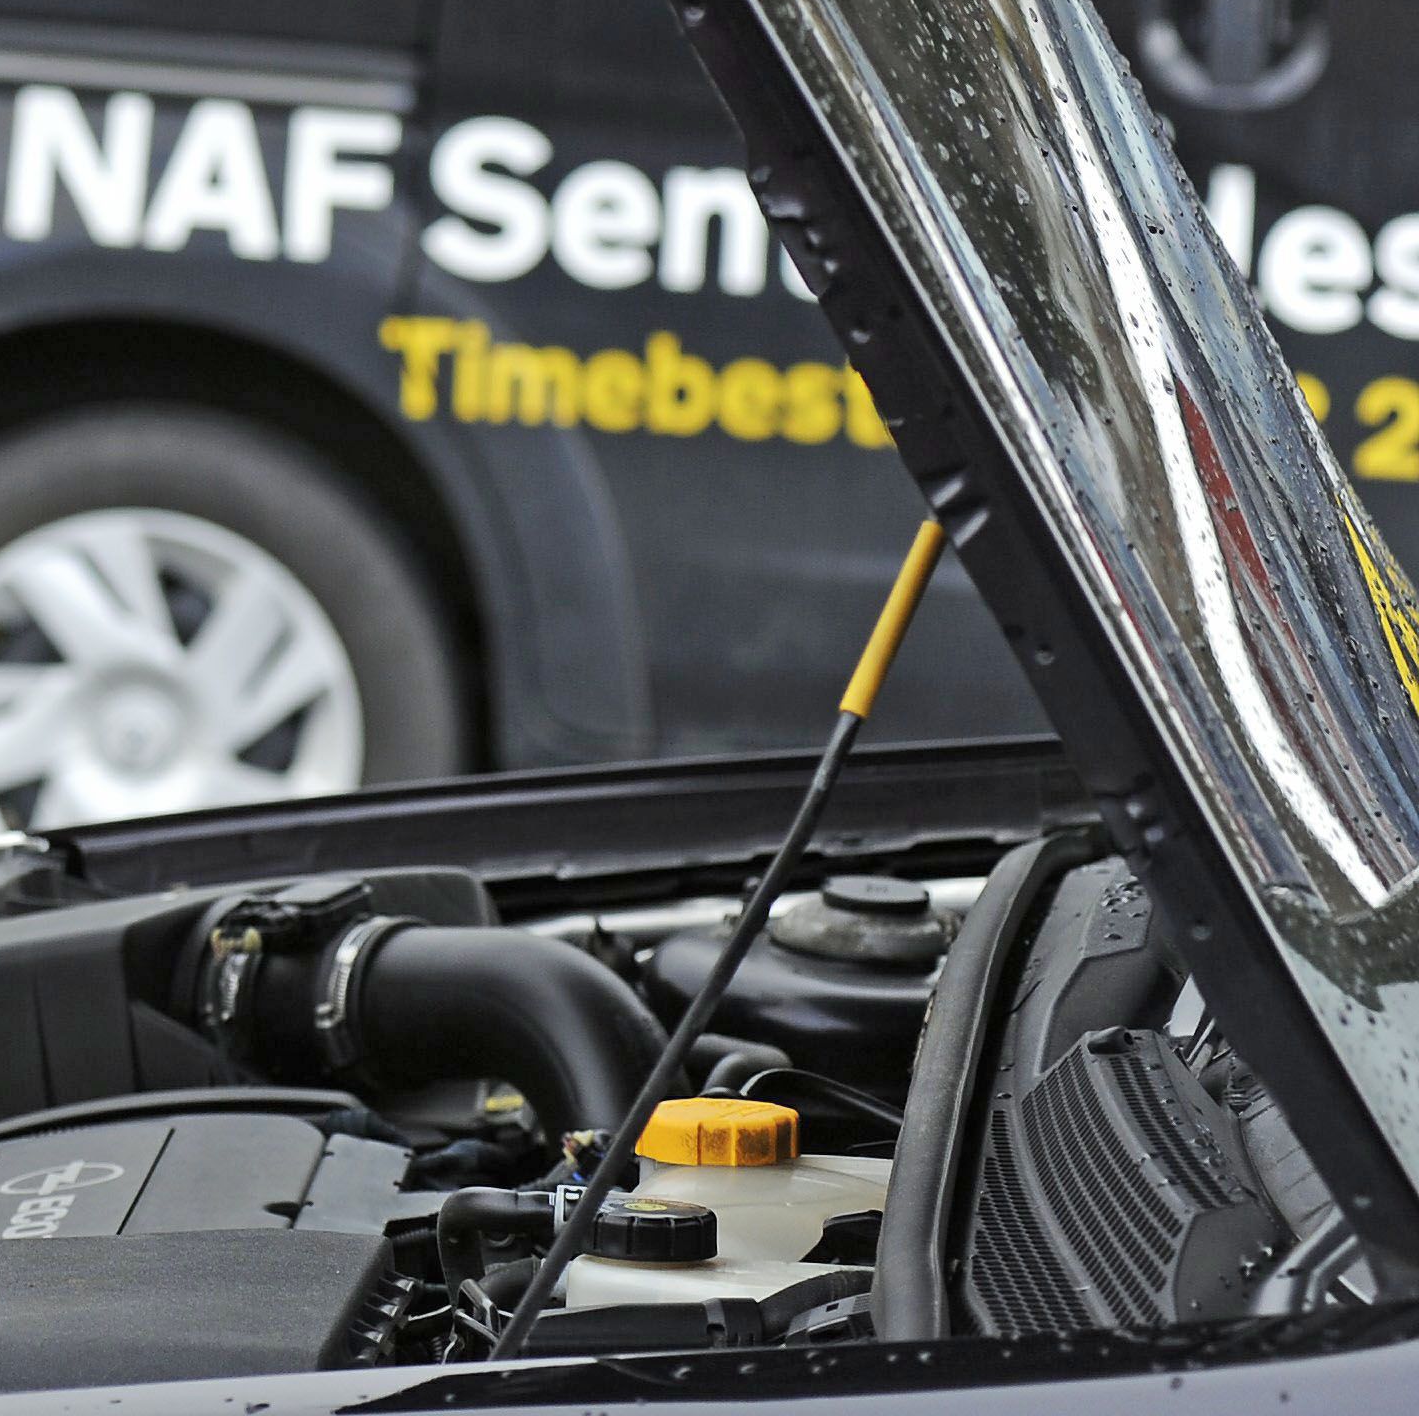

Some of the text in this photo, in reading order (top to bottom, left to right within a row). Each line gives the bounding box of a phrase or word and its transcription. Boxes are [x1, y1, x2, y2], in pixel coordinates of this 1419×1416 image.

[3, 86, 402, 264] NAF
[420, 115, 819, 303] Sen
[3, 1194, 75, 1239] ECO
